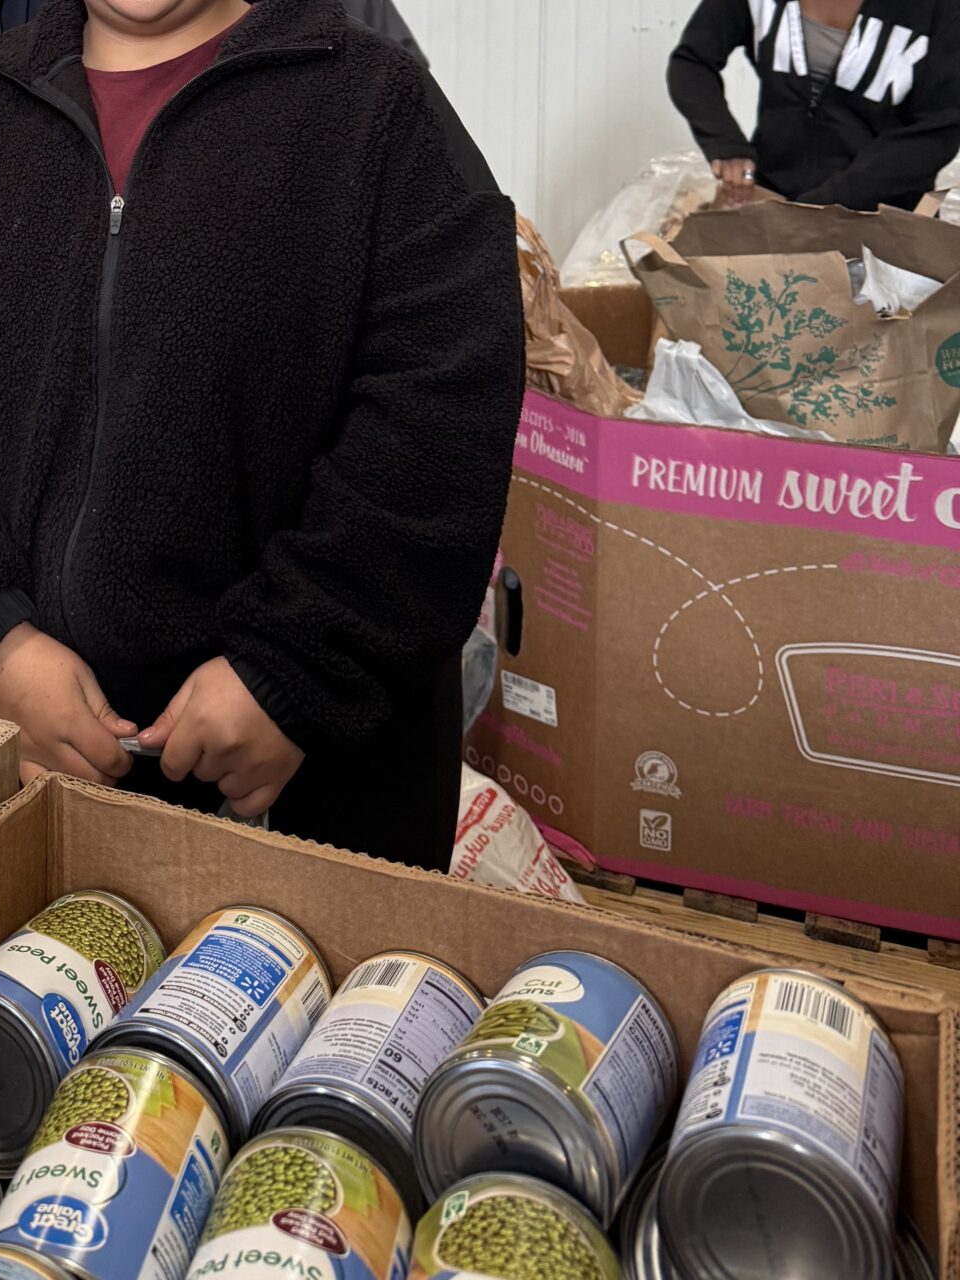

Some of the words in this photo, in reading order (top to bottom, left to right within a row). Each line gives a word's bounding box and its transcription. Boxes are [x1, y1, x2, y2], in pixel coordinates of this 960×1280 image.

[632, 454, 763, 505] PREMIUM
[778, 462, 923, 523] sweet
[644, 828, 667, 840] NO
[7, 944, 56, 965] Peas
[56, 963, 104, 1029] Sweet
[503, 987, 556, 1000] eans
[524, 978, 563, 988] Cut
[50, 1006, 81, 1065] Great
[58, 1002, 82, 1043] Value
[384, 1048, 403, 1063] 60
[366, 1076, 401, 1106] Facts
[28, 1164, 103, 1189] Sweet
[36, 1204, 83, 1222] Value
[30, 1213, 95, 1245] Great
[233, 1249, 323, 1280] Sweet
